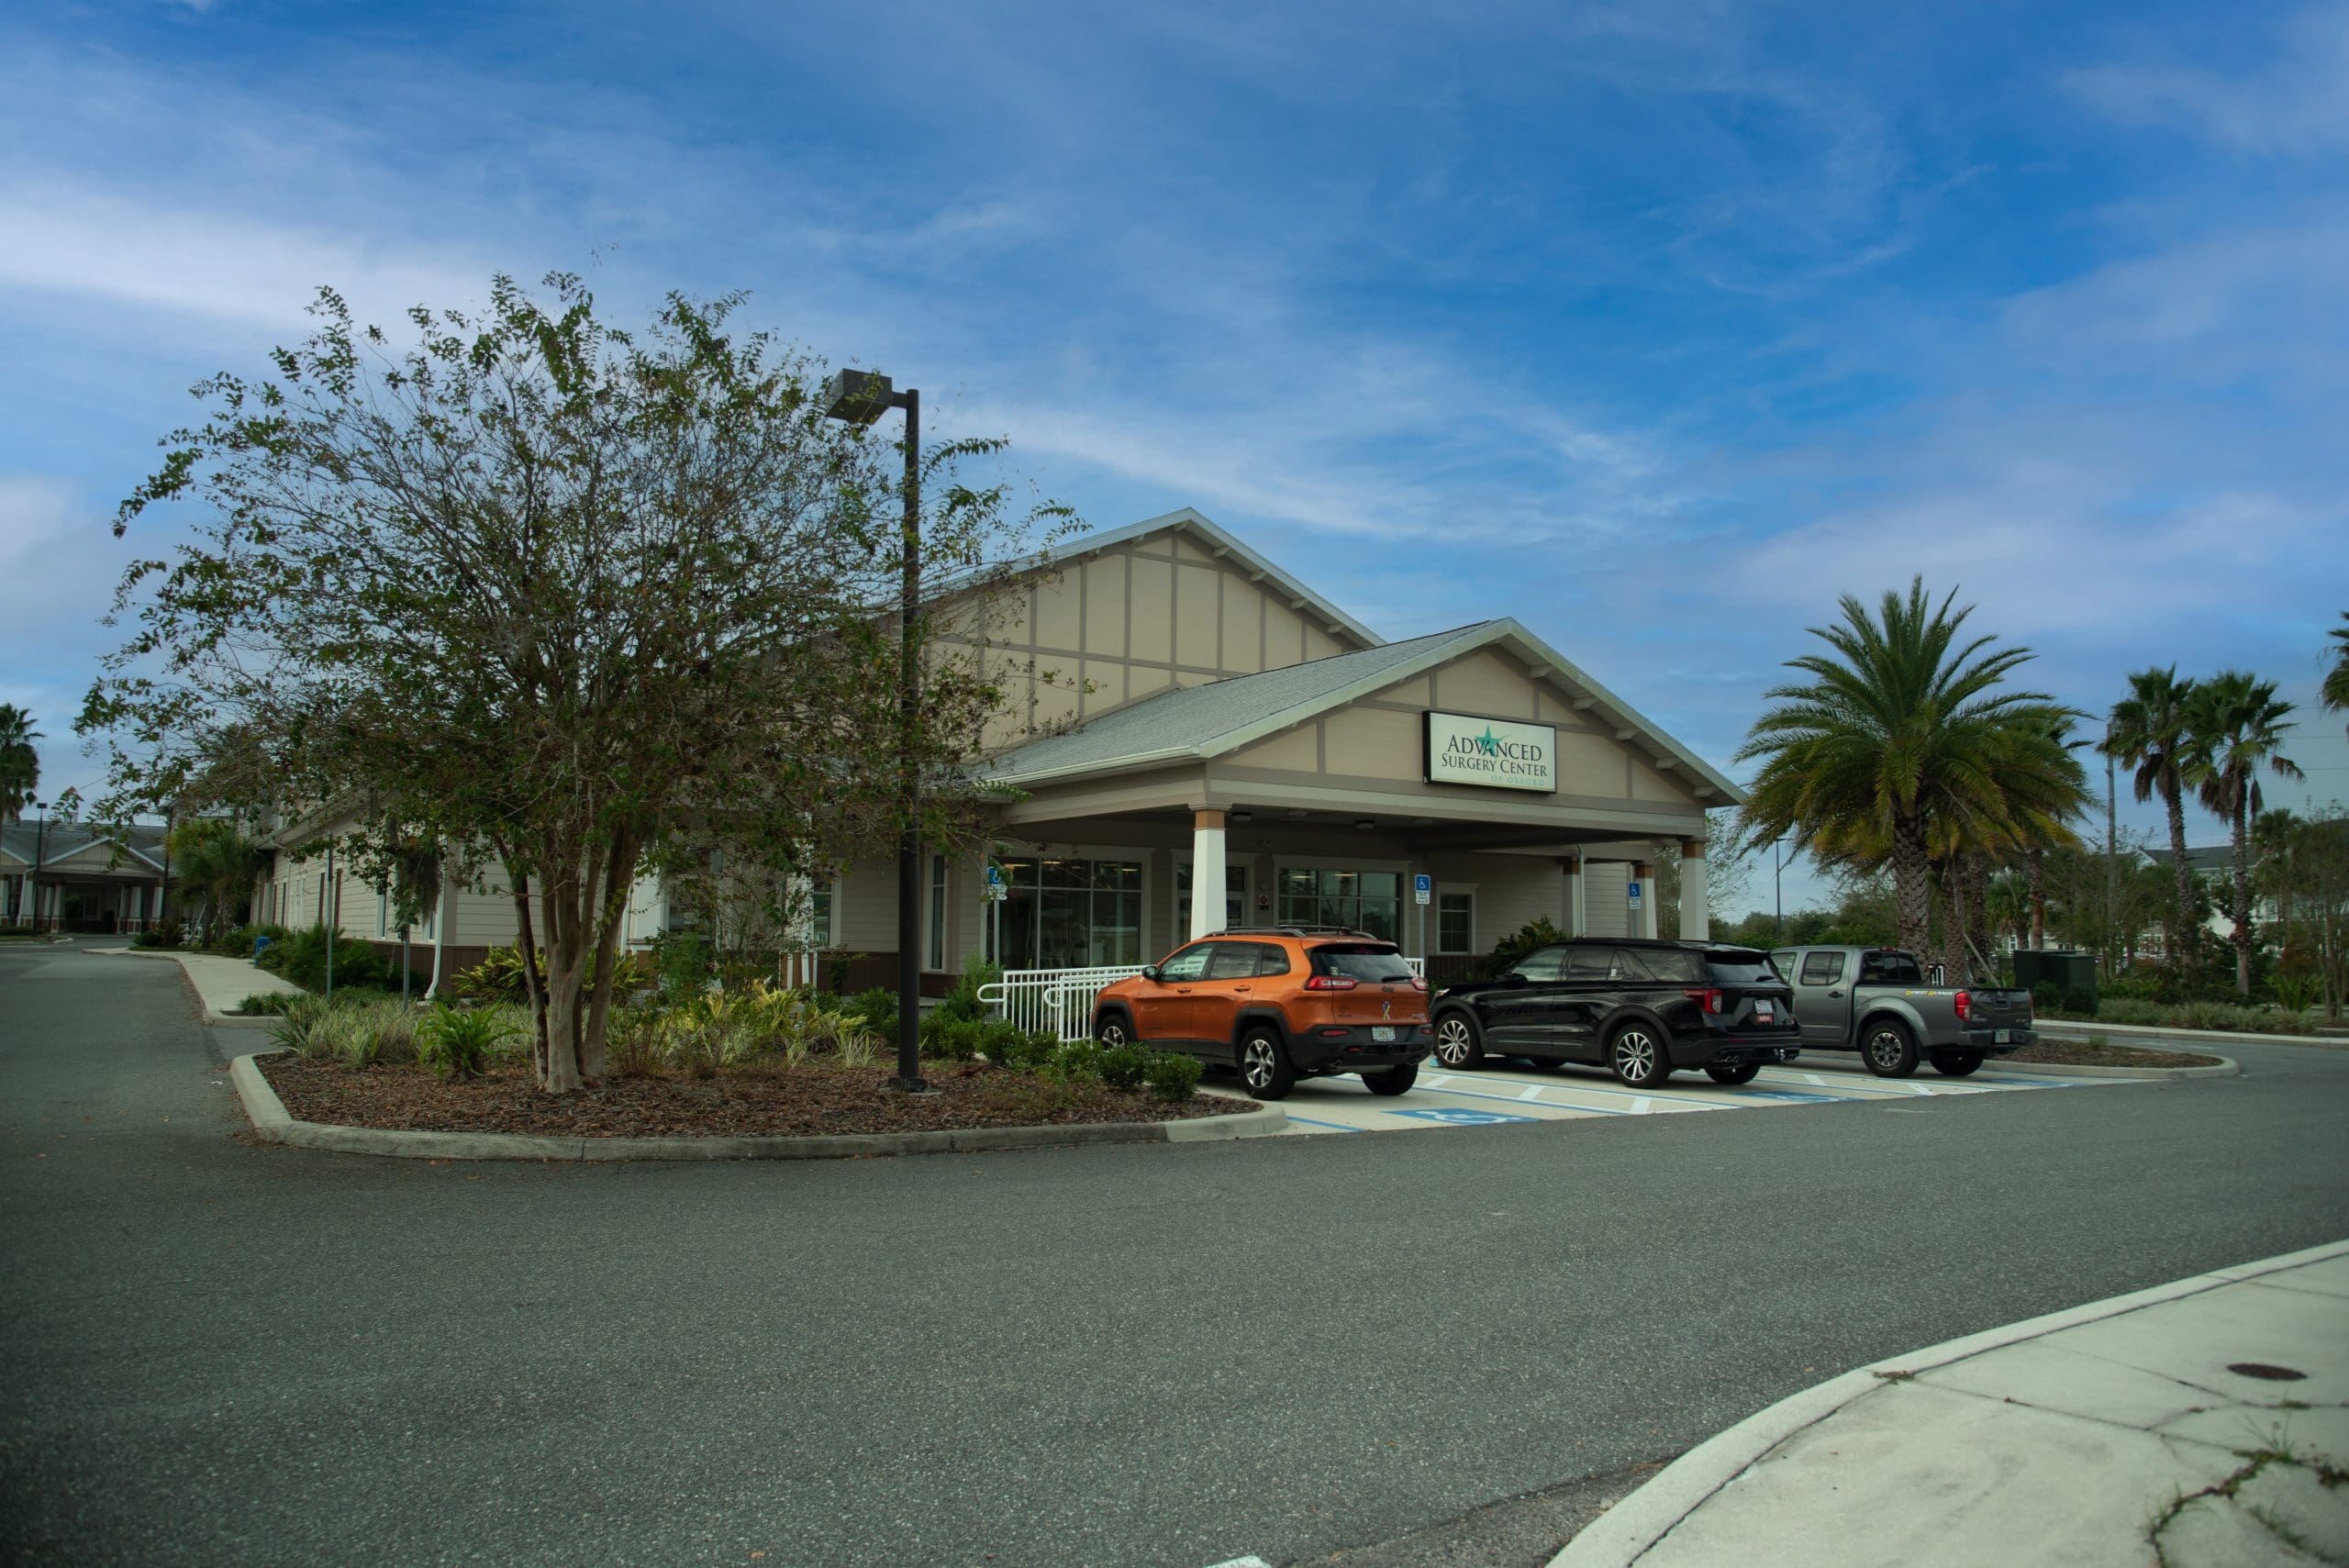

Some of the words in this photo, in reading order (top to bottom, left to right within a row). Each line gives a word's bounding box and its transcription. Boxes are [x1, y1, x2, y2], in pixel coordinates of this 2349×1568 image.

[1447, 734, 1542, 762] ADVANCED
[1442, 753, 1497, 772] SURGERY
[1500, 760, 1548, 777] CENTER
